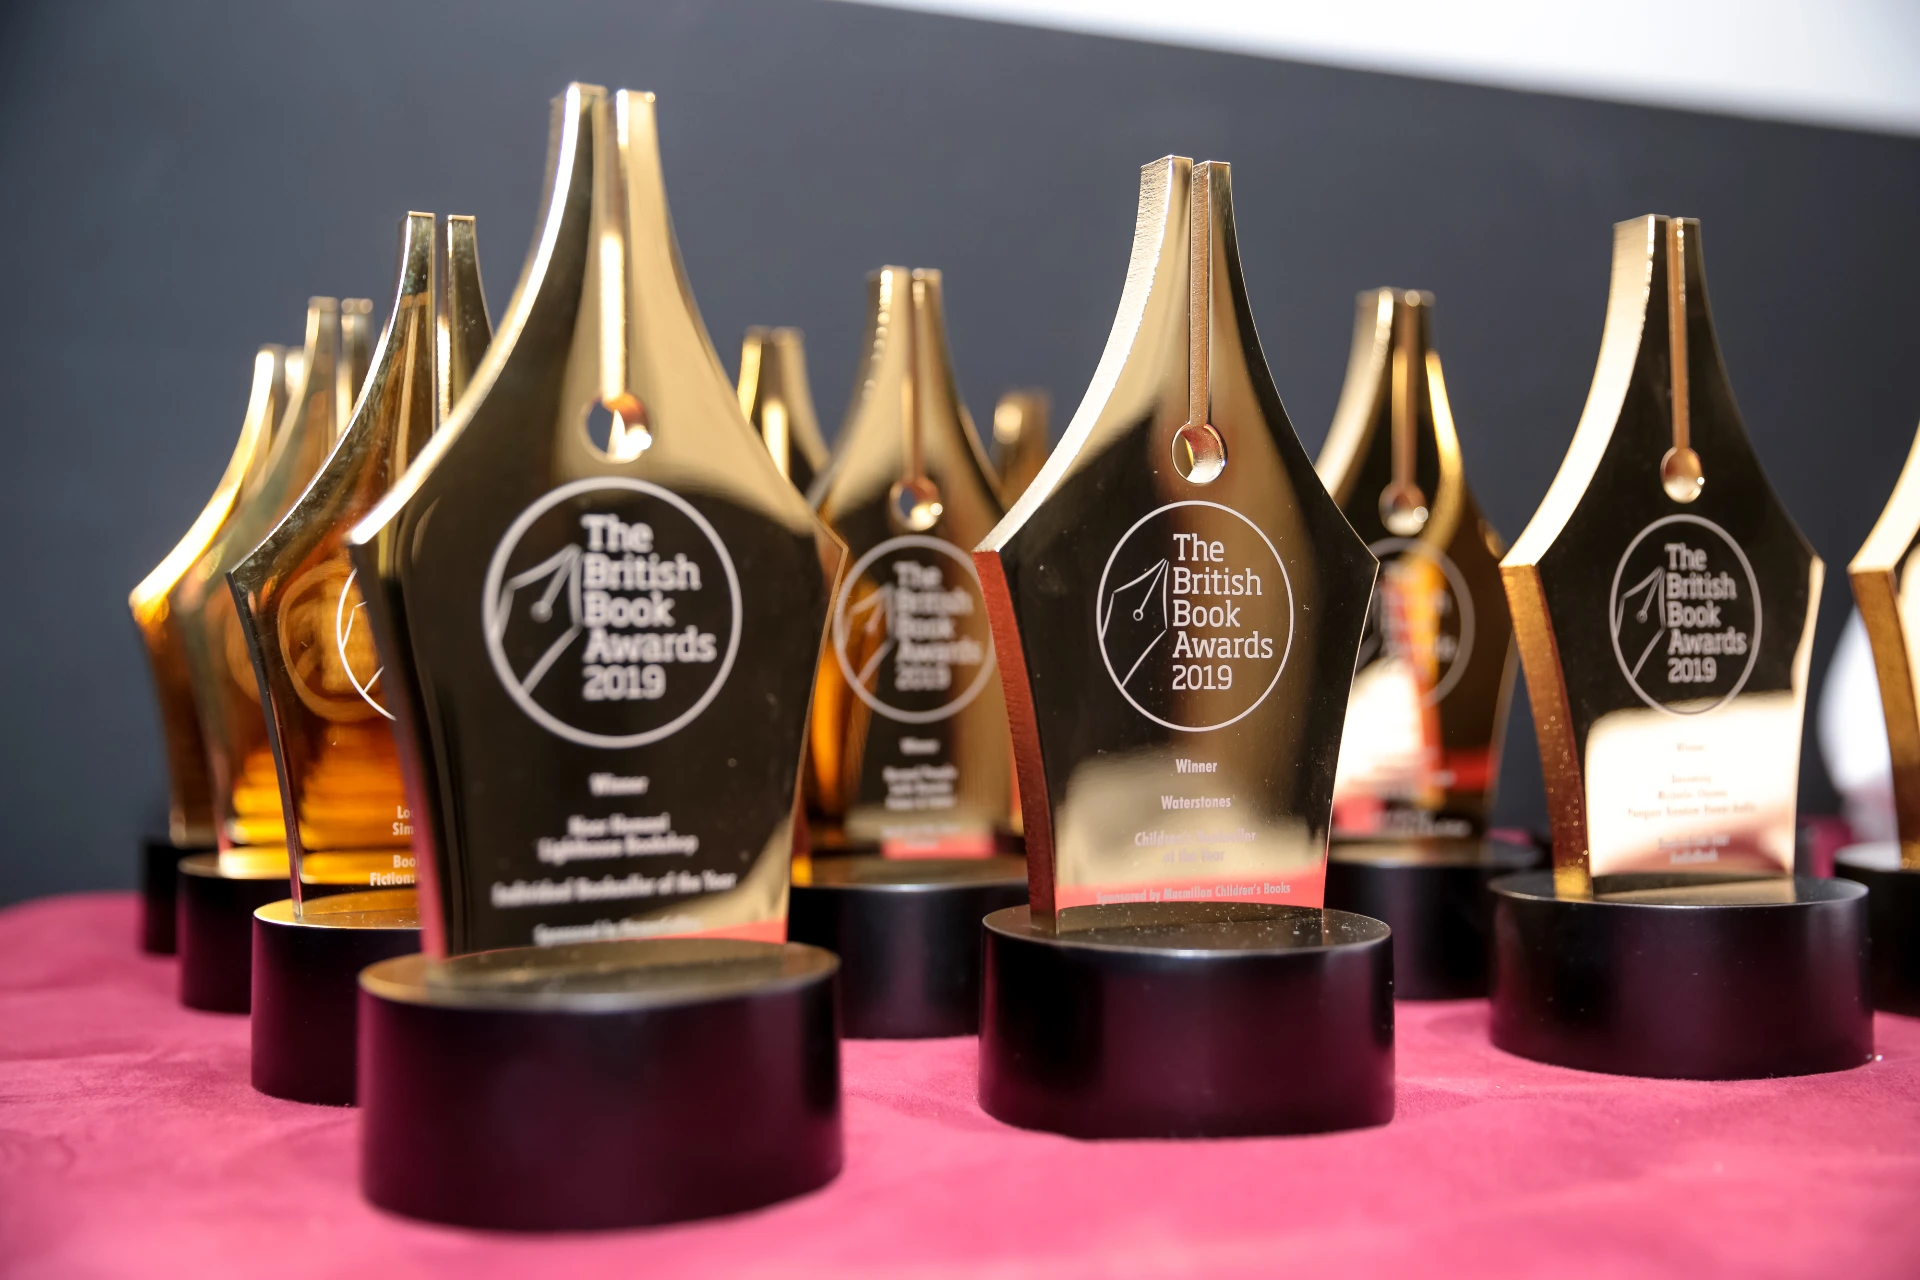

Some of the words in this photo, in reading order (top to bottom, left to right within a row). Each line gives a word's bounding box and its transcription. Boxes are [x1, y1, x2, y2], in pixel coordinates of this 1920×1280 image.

[581, 514, 653, 553] The
[1173, 533, 1224, 562] The
[1664, 542, 1707, 571] The
[582, 552, 701, 590] British
[1173, 567, 1262, 596] British
[1665, 571, 1737, 599] British
[582, 590, 676, 628] Book
[1173, 599, 1241, 627] Book
[1666, 600, 1721, 628] Book
[582, 625, 717, 663] Awards
[1172, 631, 1273, 659] Awards
[1667, 626, 1747, 655] Awards
[582, 665, 666, 700] 2019
[1172, 664, 1232, 690] 2019
[1668, 657, 1716, 683] 2019
[1176, 758, 1217, 774] Winner
[1161, 795, 1231, 811] Waterstones
[1134, 830, 1192, 847] Children's
[1096, 888, 1146, 906] Sponsored
[1150, 887, 1160, 904] by
[1164, 885, 1212, 899] Macmillan
[1215, 883, 1261, 897] Children's
[1263, 881, 1290, 894] Books
